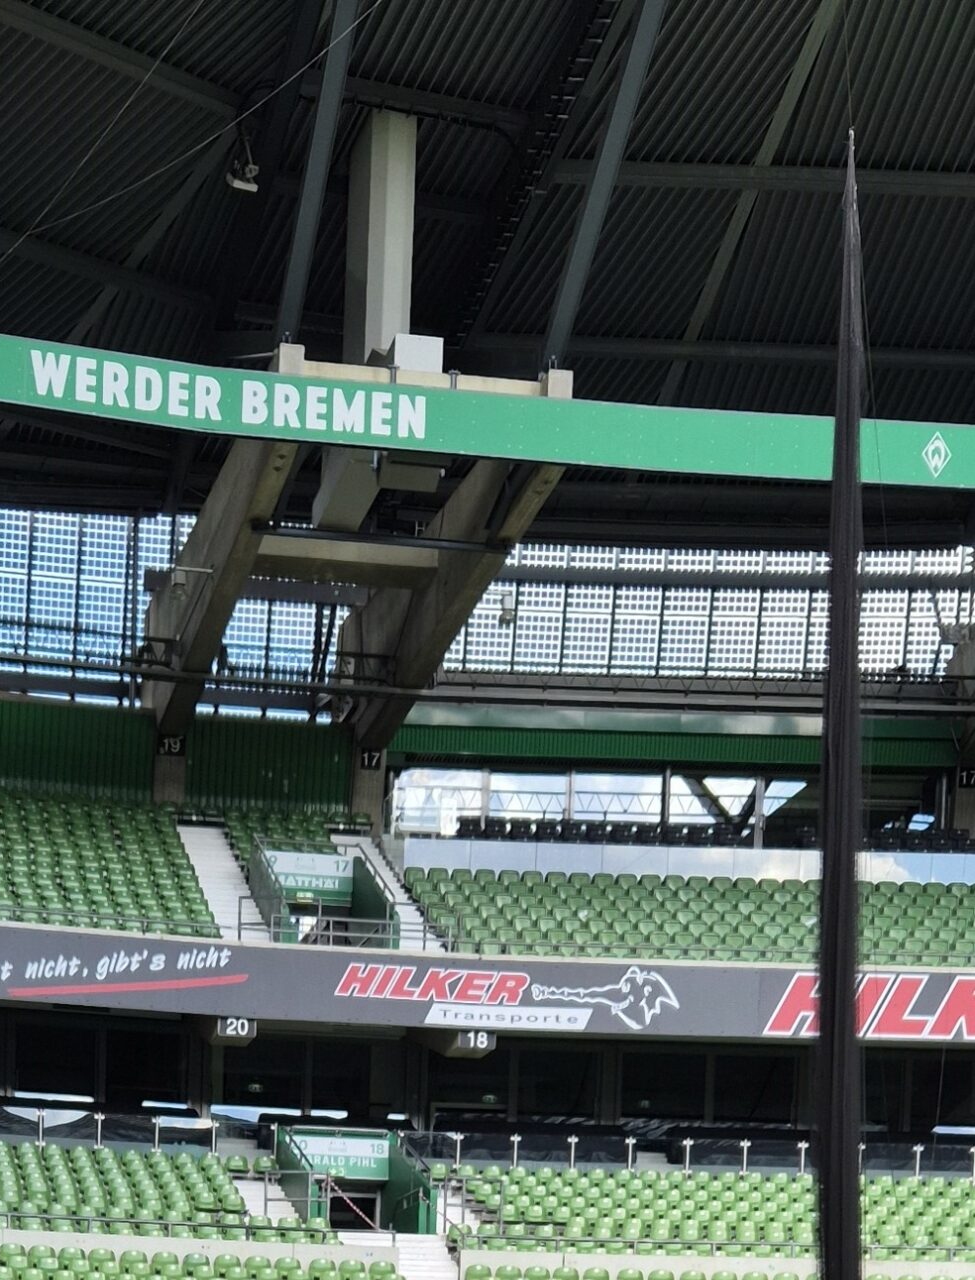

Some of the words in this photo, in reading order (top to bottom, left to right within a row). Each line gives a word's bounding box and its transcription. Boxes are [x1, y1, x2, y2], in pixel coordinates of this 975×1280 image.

[30, 349, 222, 421] WERDER
[241, 380, 426, 439] BREMEN
[362, 752, 380, 766] 17
[334, 860, 349, 872] 17
[24, 953, 89, 981] nicht,
[95, 948, 167, 981] gibt's
[177, 945, 232, 971] nicht
[334, 962, 530, 1006] HILKER
[439, 1009, 580, 1025] Transporte
[226, 1018, 249, 1036] 20
[466, 1032, 488, 1049] 18
[370, 1143, 384, 1155] 18
[349, 1157, 377, 1168] PIHL
